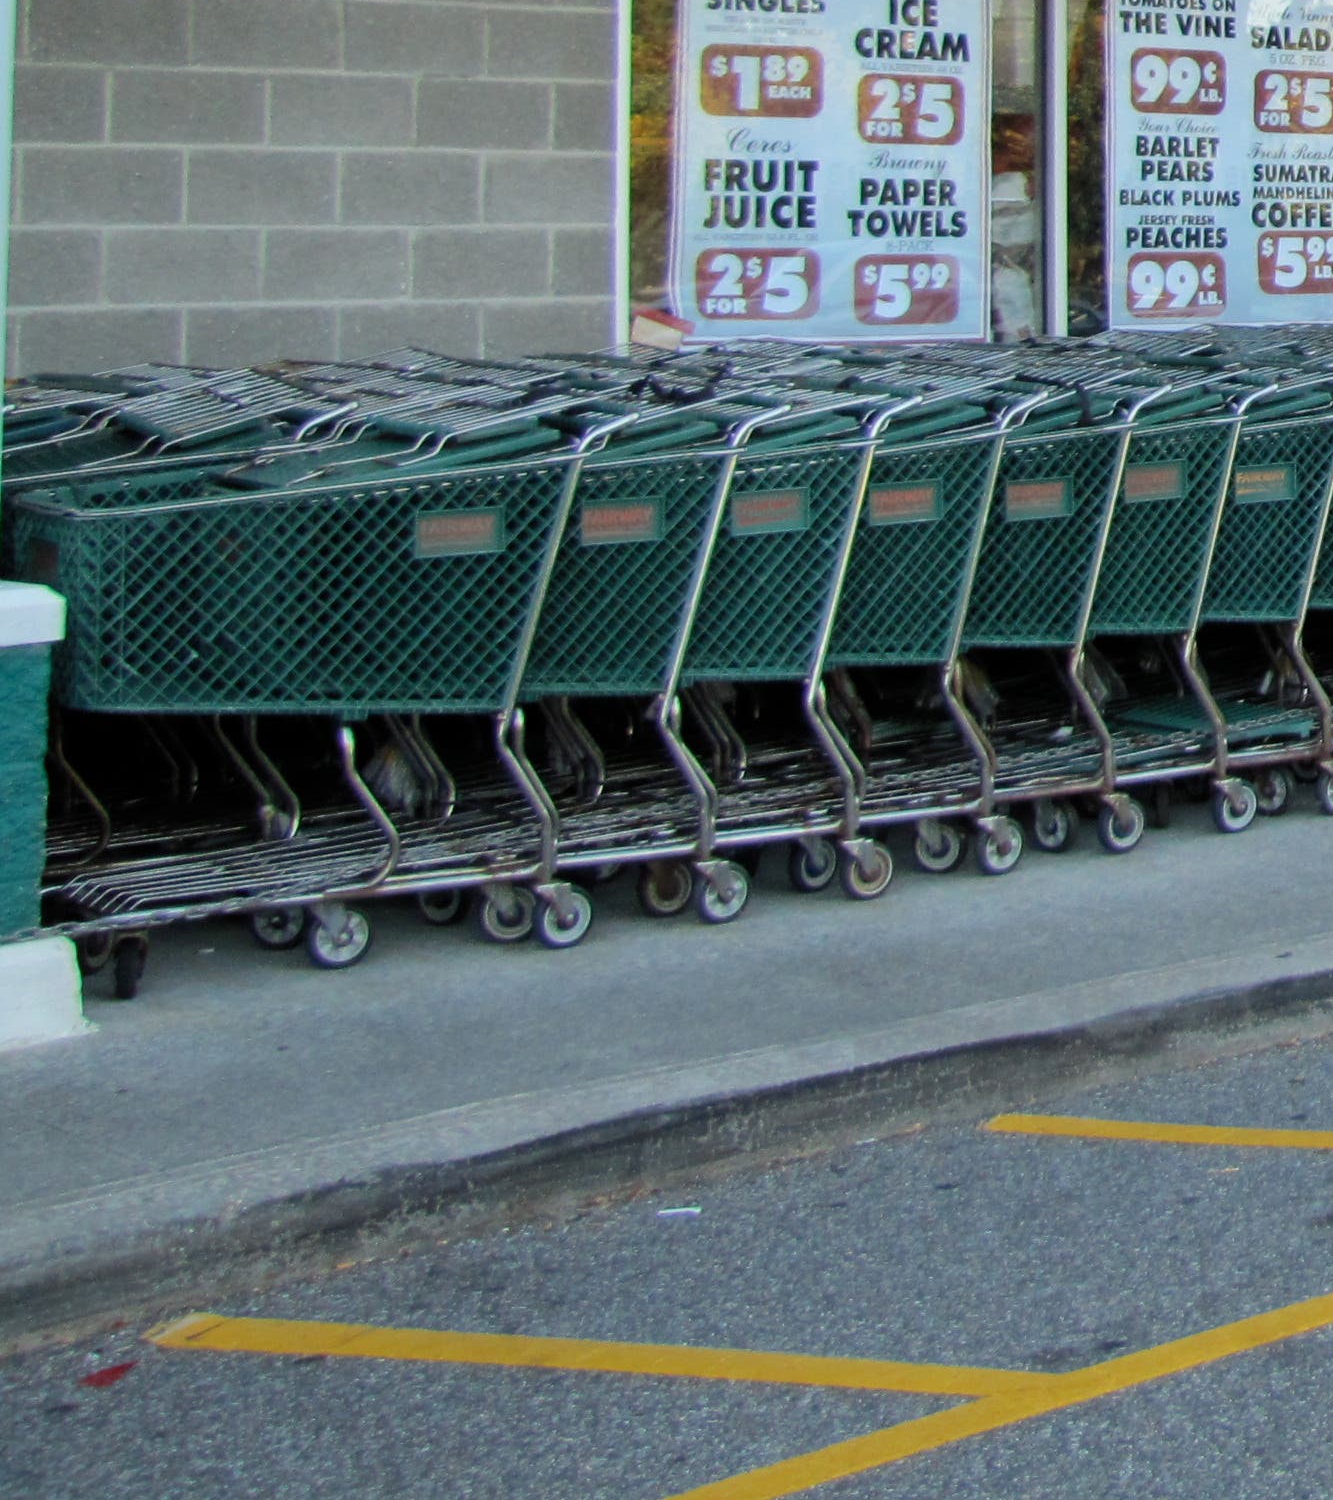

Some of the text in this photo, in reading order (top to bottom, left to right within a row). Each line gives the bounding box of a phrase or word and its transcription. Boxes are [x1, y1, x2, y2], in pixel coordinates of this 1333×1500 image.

[1119, 10, 1237, 38] THE VINE
[854, 28, 971, 63] CREAM
[768, 85, 812, 100] EACH
[867, 121, 903, 138] FOR
[1137, 117, 1217, 132] Your Choice
[1259, 112, 1291, 127] FOR
[726, 126, 793, 153] Ceres
[1135, 135, 1220, 158] BARLET
[1248, 143, 1287, 160] Fresh
[704, 159, 820, 192] FRUIT
[868, 151, 948, 179] Brawny
[1140, 160, 1215, 182] PEARS
[859, 178, 958, 207] PAPER
[1119, 188, 1241, 207] BLACK PLUMS
[702, 195, 817, 229] JUICE
[1138, 215, 1215, 226] JERSEY FRESH
[847, 209, 968, 238] TOWELS
[1126, 227, 1228, 249] PEACHES
[706, 298, 747, 315] FOR
